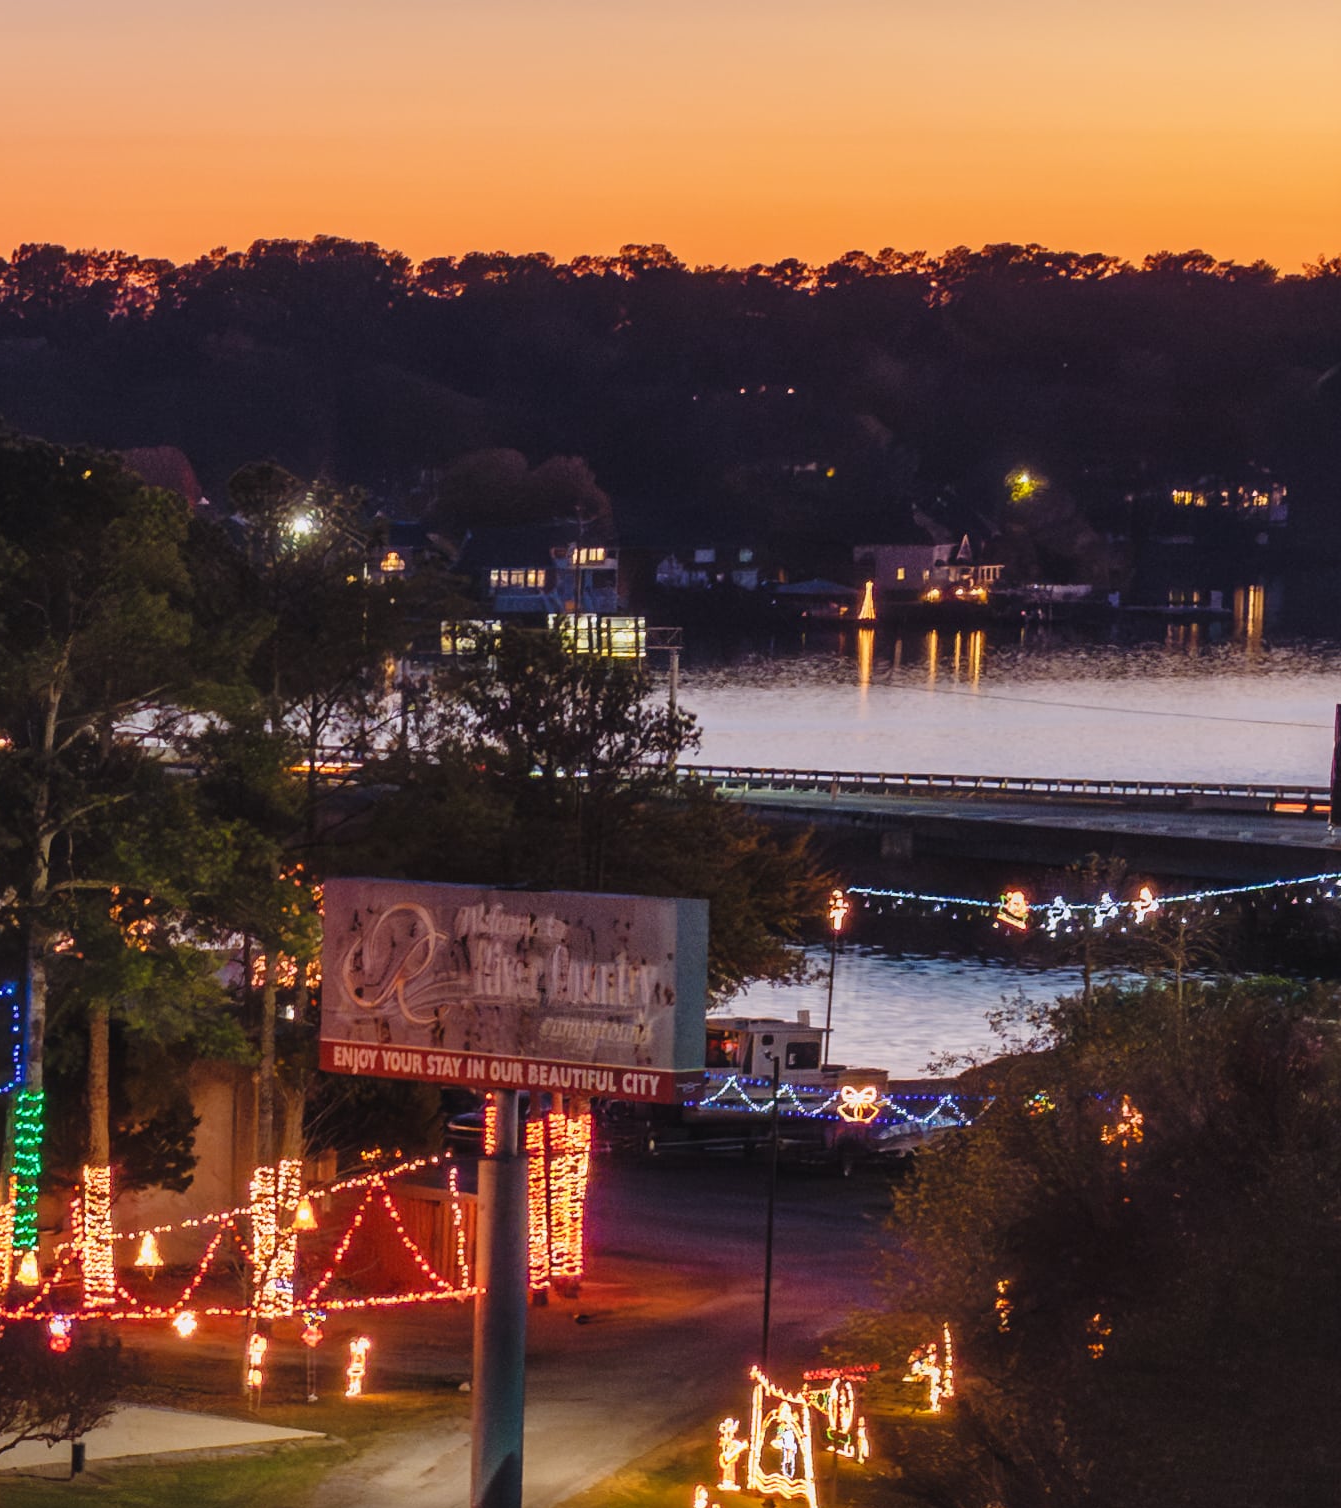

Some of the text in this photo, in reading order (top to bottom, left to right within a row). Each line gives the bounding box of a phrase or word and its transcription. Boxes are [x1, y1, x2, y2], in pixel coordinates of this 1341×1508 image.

[333, 1046, 661, 1097] ENJOY YOUR STAY IN OUR BEAUTIFUL CITY
